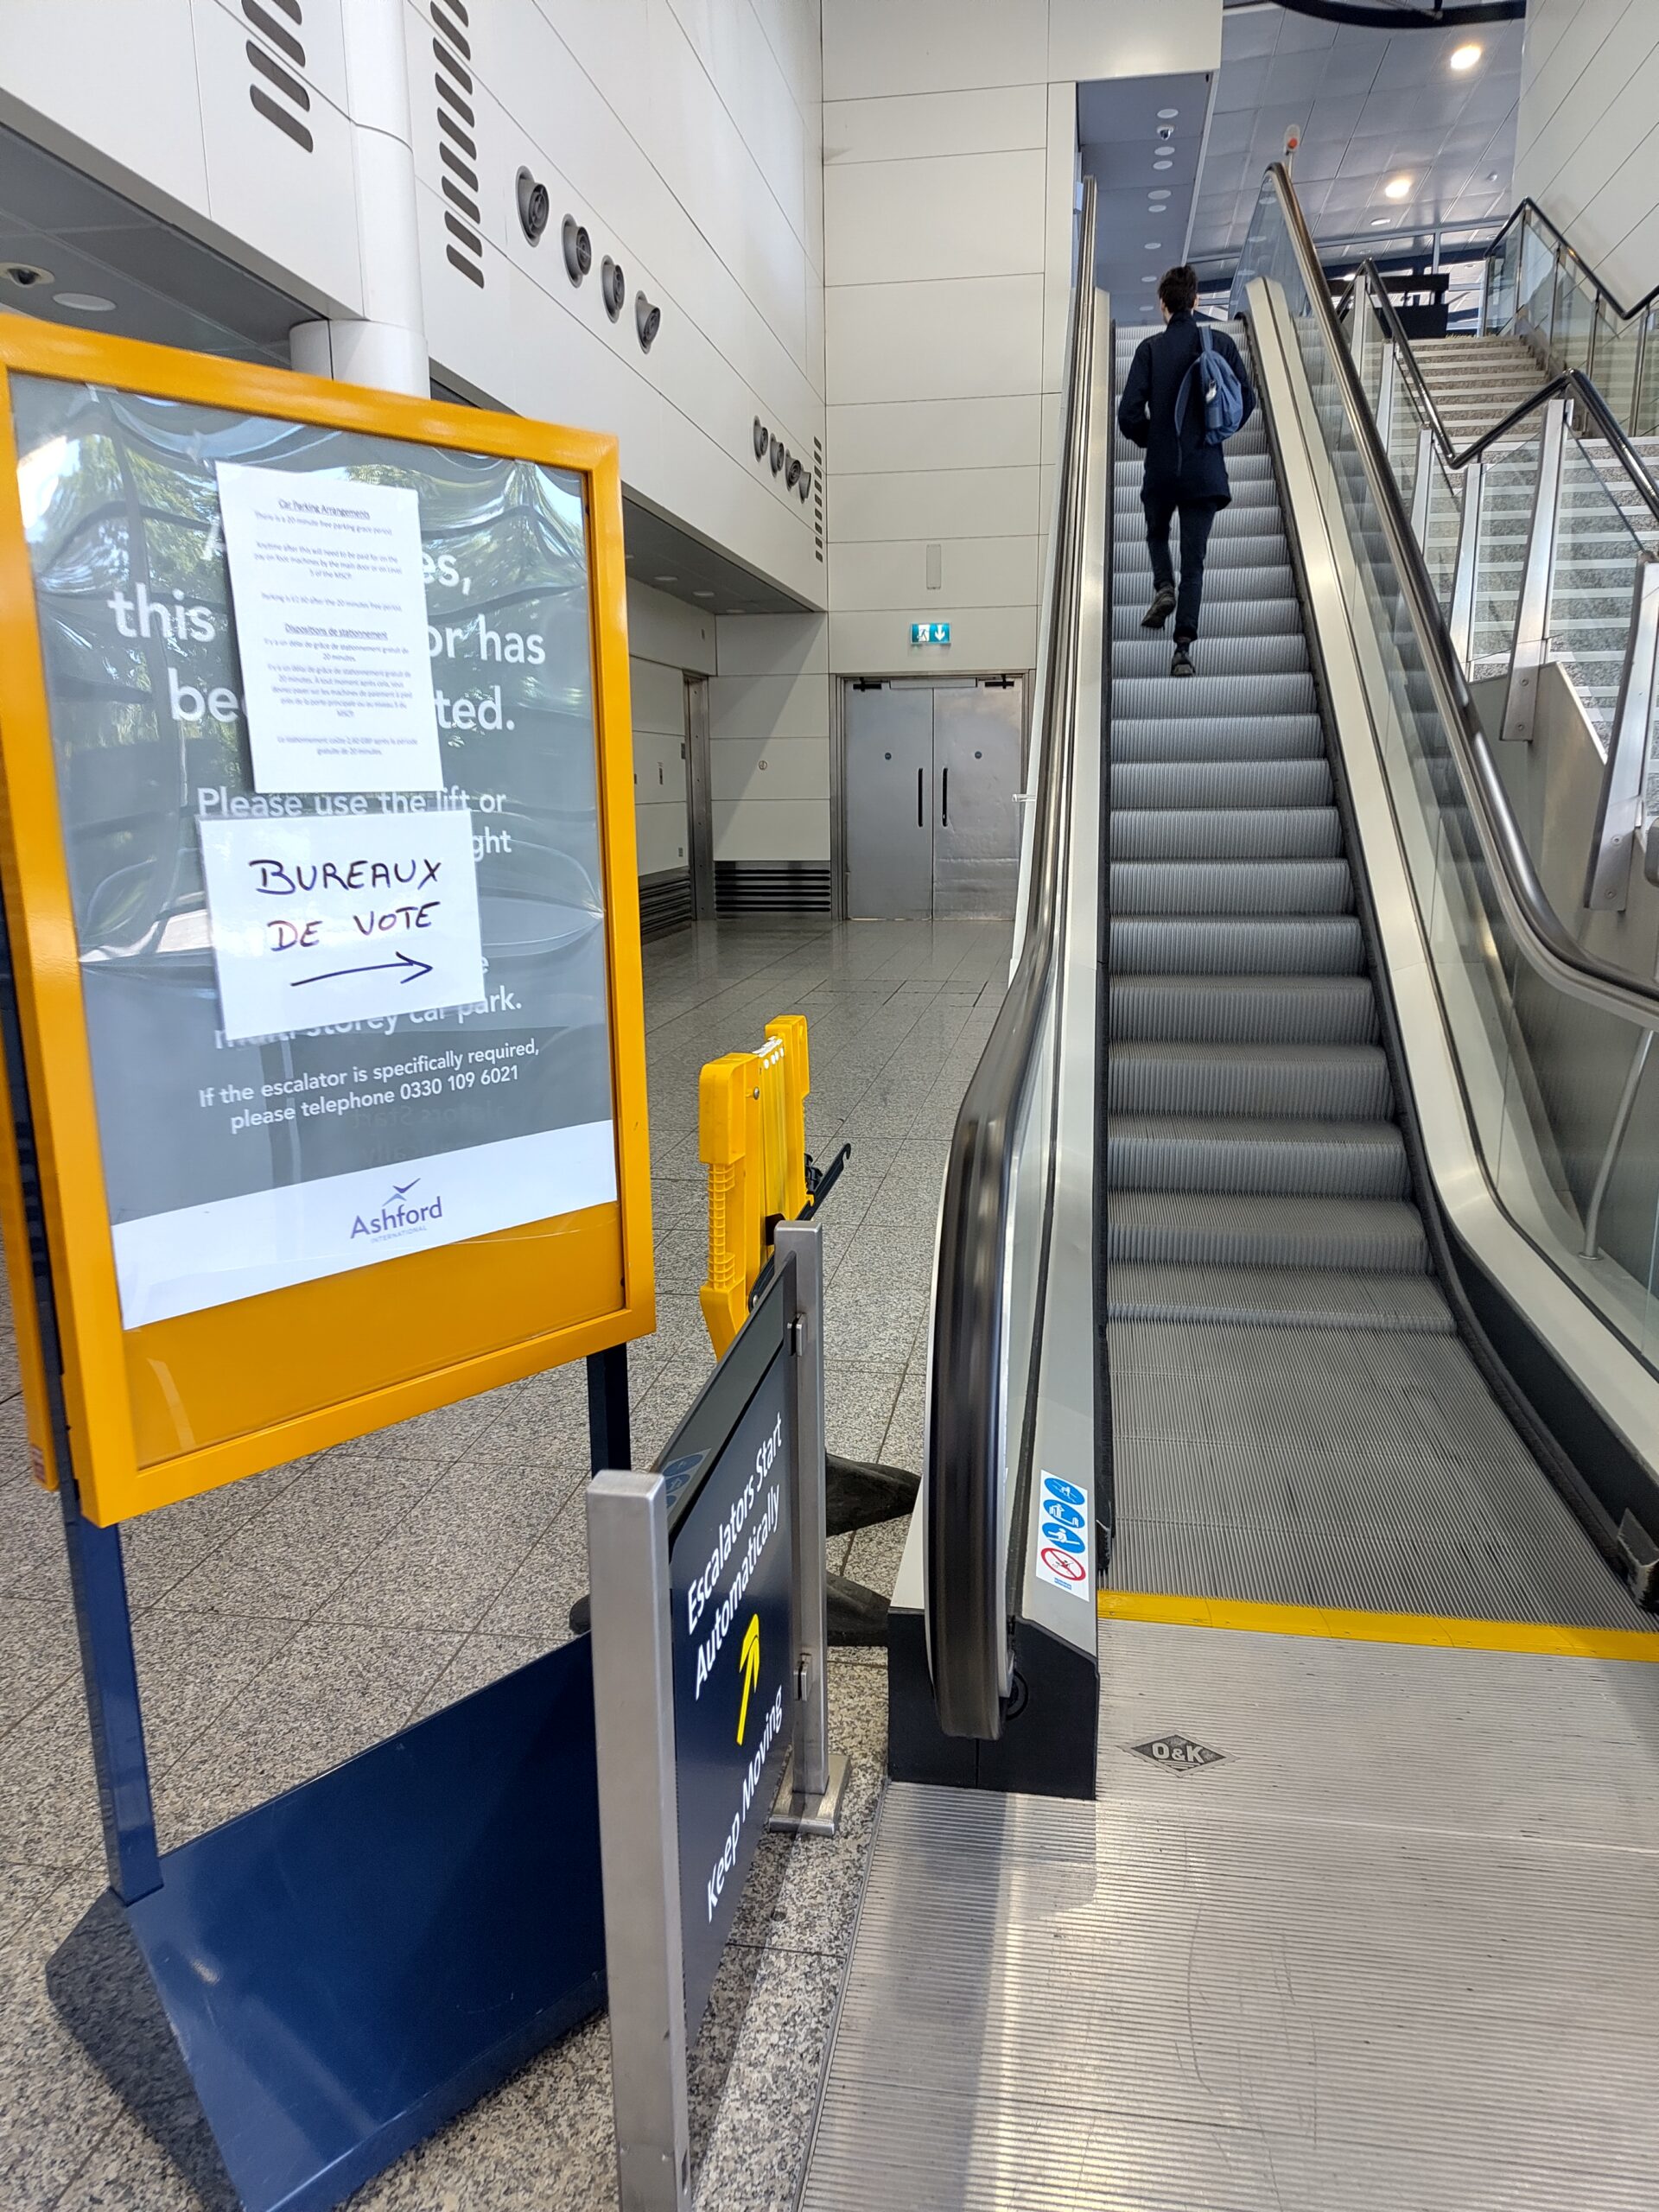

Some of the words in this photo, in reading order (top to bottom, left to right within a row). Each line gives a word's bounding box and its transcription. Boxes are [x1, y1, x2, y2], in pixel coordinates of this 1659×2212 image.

[293, 499, 320, 514] Parking
[321, 504, 371, 520] Arrangements
[105, 581, 216, 643] this
[478, 613, 546, 665] has
[197, 786, 302, 817] Please
[314, 795, 368, 815] use
[378, 791, 427, 814] the
[436, 785, 471, 811] lift
[480, 793, 507, 813] or
[248, 858, 442, 895] BUREAUX
[266, 919, 322, 952] DE
[353, 901, 441, 937] VOTE
[458, 984, 522, 1024] park.
[199, 1089, 214, 1108] If
[219, 1084, 254, 1106] the
[261, 1071, 347, 1098] escalator
[353, 1066, 368, 1083] is
[372, 1050, 463, 1083] specifically
[468, 1038, 540, 1065] required,
[230, 1104, 296, 1135] please
[301, 1089, 396, 1116] telephone
[399, 1077, 442, 1102] 0330
[447, 1073, 476, 1092] 109
[480, 1065, 519, 1085] 6021
[349, 1196, 443, 1239] Ashford
[370, 1225, 428, 1244] INTERNATIONAL
[688, 1474, 754, 1636] Escalators
[756, 1411, 782, 1493] Start
[695, 1484, 780, 1702] Automatically
[1151, 1741, 1206, 1764] O&K
[707, 1812, 742, 1924] Keep
[741, 1683, 783, 1821] Moving
